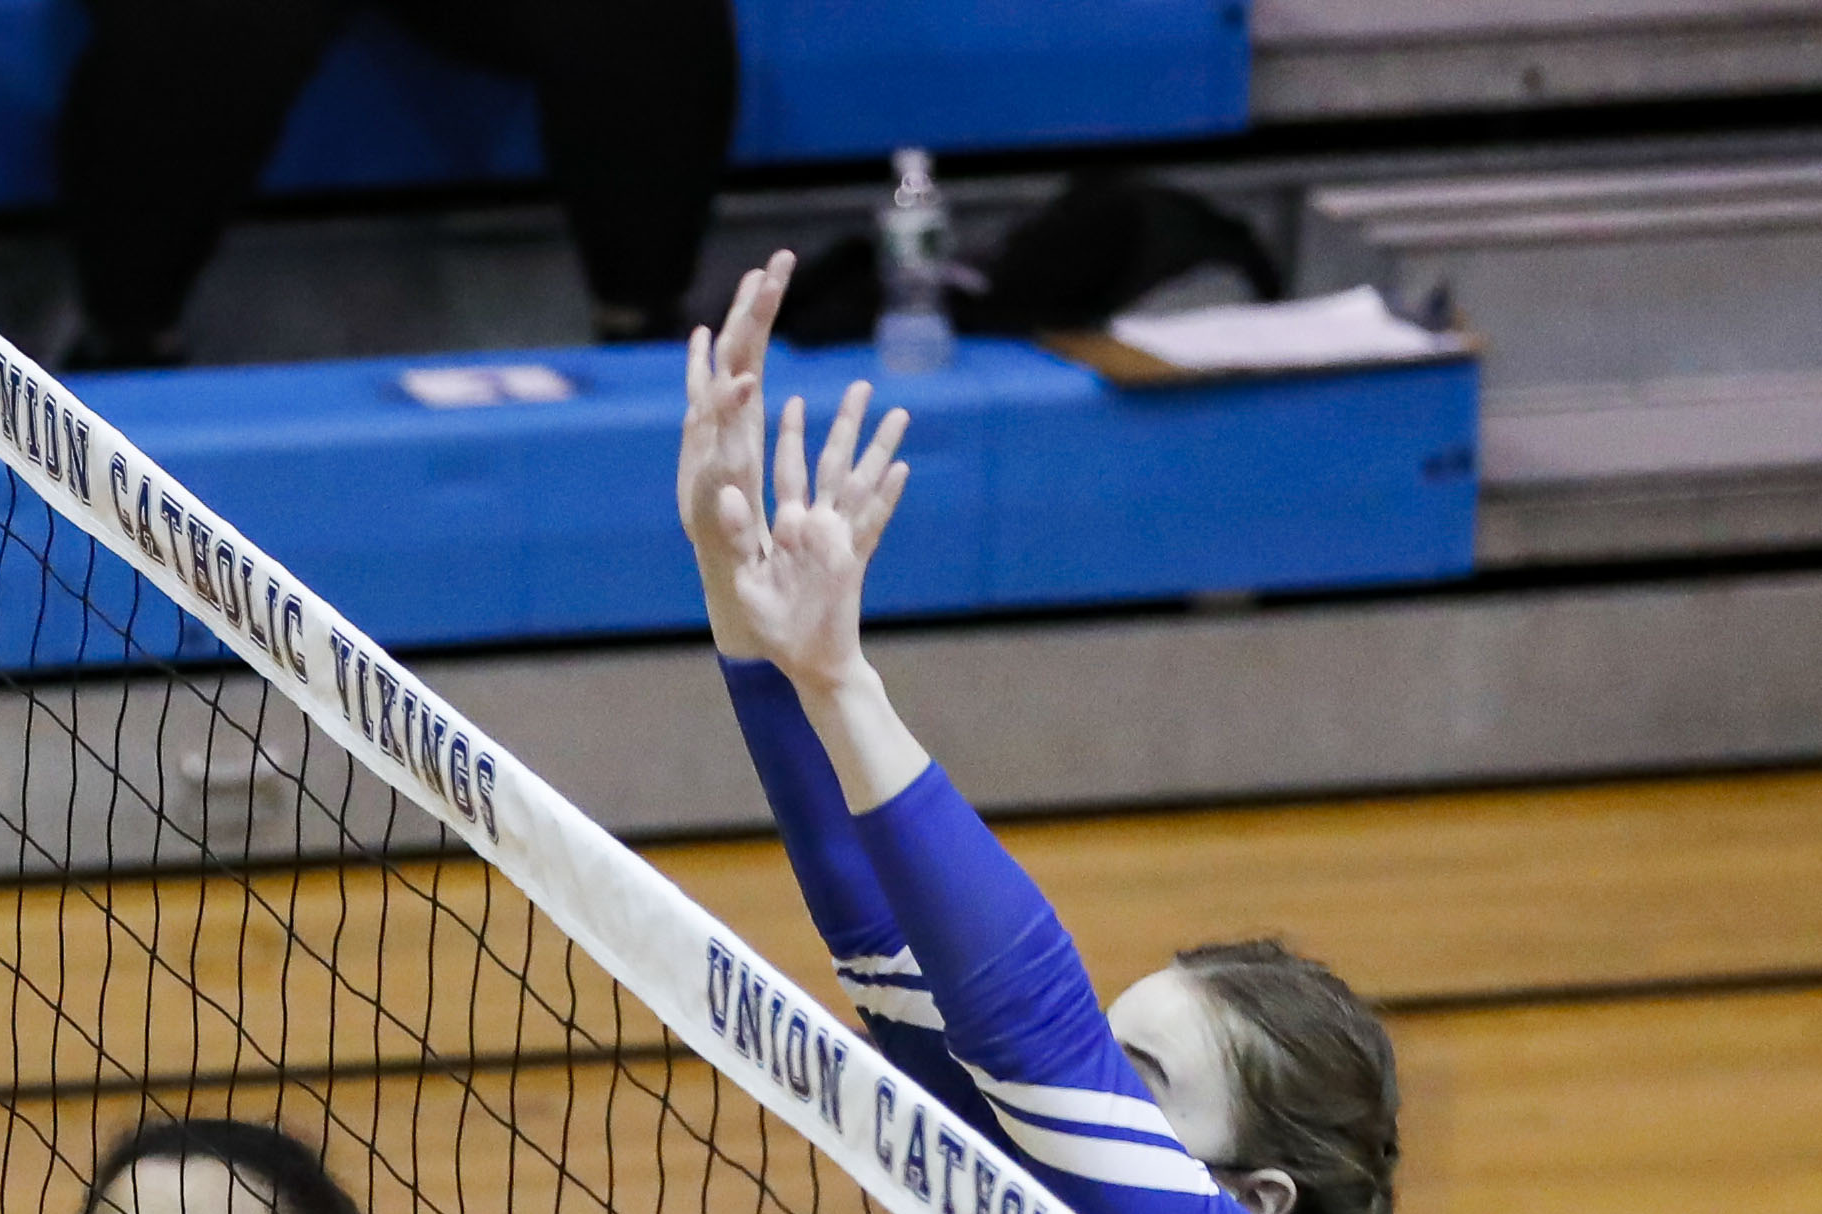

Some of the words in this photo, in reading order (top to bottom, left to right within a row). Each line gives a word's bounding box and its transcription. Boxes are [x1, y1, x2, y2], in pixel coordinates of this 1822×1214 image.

[109, 452, 309, 684] CATHOLIC
[330, 627, 499, 844] VIKINGS
[705, 938, 847, 1134] UNION
